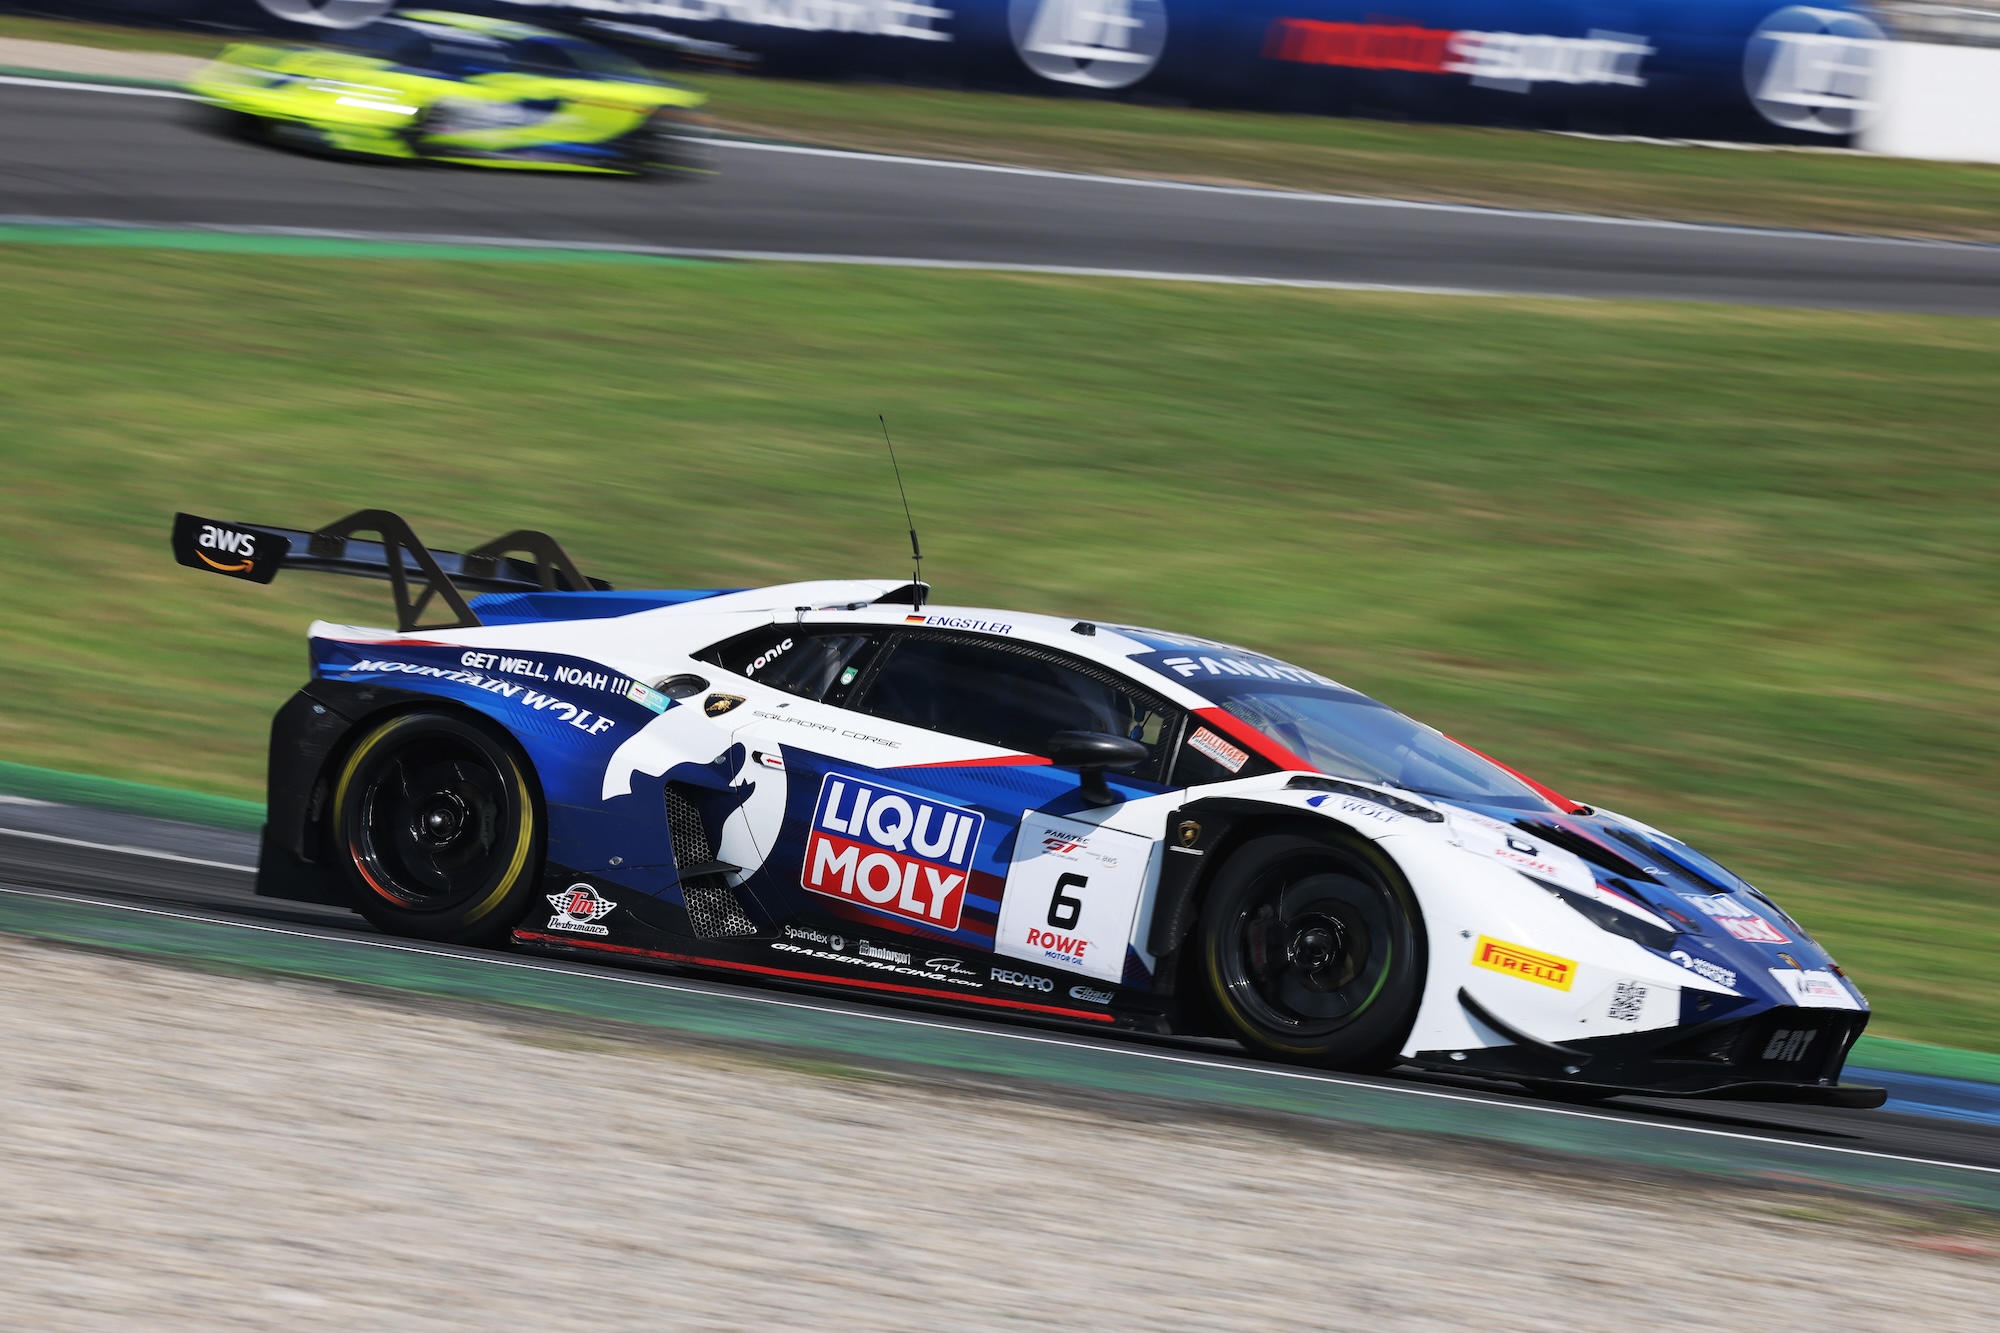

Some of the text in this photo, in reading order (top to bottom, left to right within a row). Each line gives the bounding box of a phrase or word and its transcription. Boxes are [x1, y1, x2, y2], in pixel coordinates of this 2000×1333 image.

[199, 525, 256, 557] aws
[926, 616, 1012, 635] ENGSTLER
[460, 651, 631, 696] GET WELL, NOAH !!!
[746, 638, 793, 677] sonic
[348, 659, 524, 698] MOUNTAIN
[752, 710, 902, 750] SQUADRA CORSE
[822, 781, 974, 865] LIQUI
[811, 837, 964, 920] MOLY
[1047, 872, 1089, 931] 6
[785, 925, 828, 945] Spandex
[1026, 927, 1088, 958] ROWE
[1045, 950, 1084, 966] MOTOR OIL
[1481, 943, 1569, 984] PIRELLI
[990, 967, 1055, 993] RECARO
[1068, 985, 1115, 1002] Eibach
